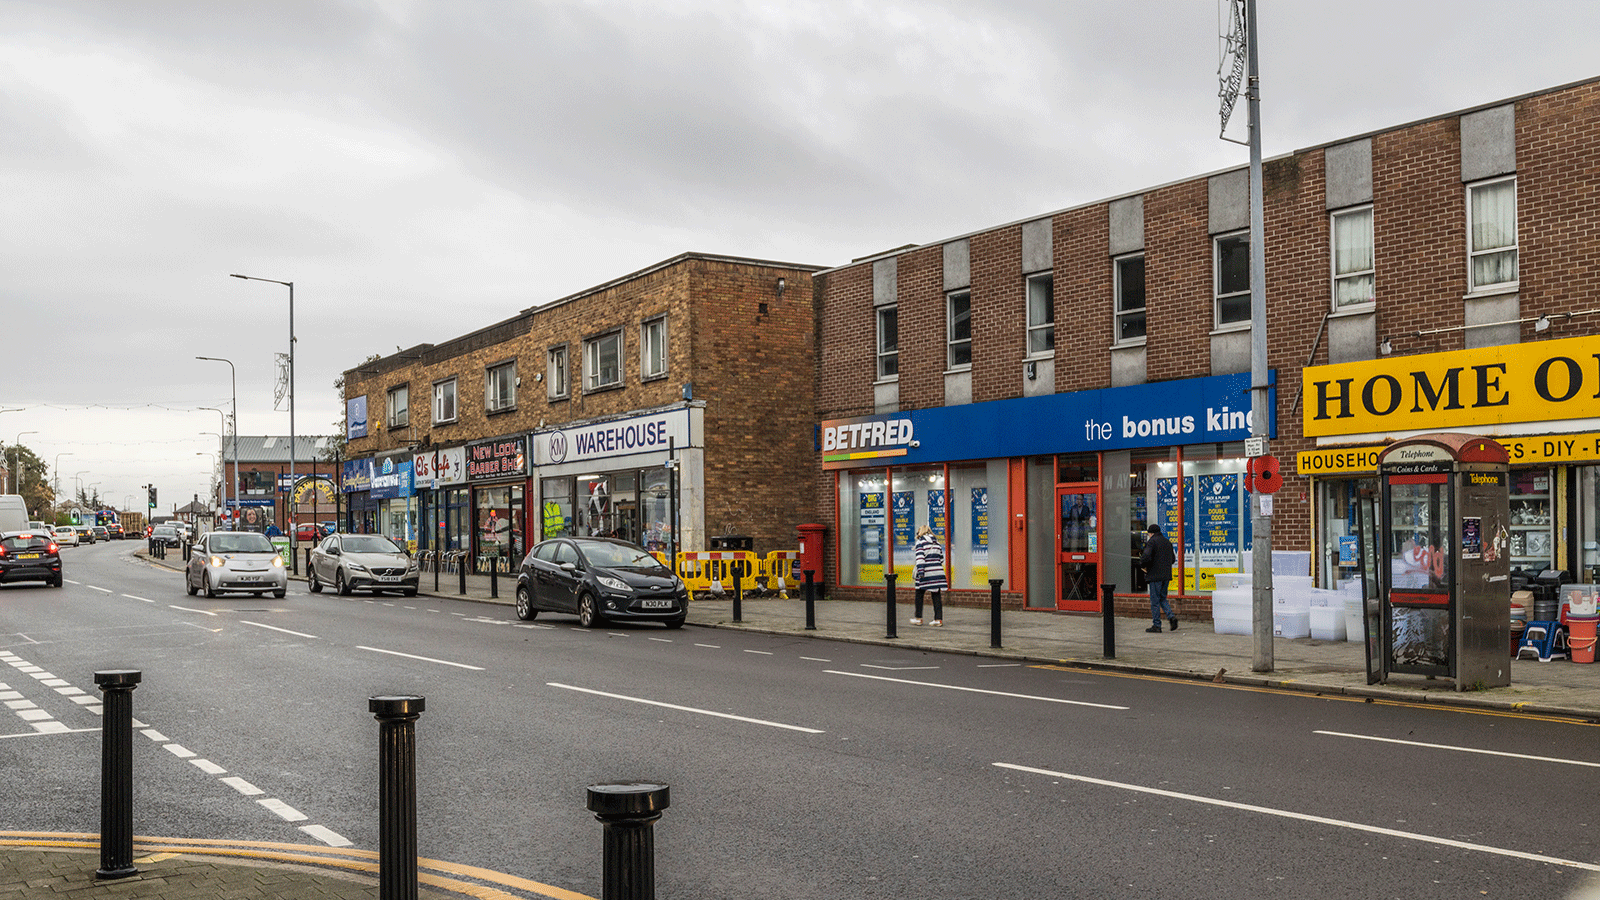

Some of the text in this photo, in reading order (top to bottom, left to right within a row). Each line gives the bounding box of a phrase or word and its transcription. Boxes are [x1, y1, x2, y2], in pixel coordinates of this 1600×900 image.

[1313, 353, 1600, 420] HOME O
[551, 421, 667, 456] KM WAREHOUSE
[824, 419, 913, 451] BETFRED
[1085, 419, 1112, 441] the
[1122, 415, 1195, 438] bonus
[473, 442, 517, 460] NEW LOOK
[1302, 452, 1378, 470] HOUSEHO
[1544, 440, 1575, 457] DIY
[1400, 450, 1434, 460] Telephone
[470, 461, 500, 475] BARBER
[502, 457, 518, 471] SHO
[1470, 473, 1498, 485] Telephone
